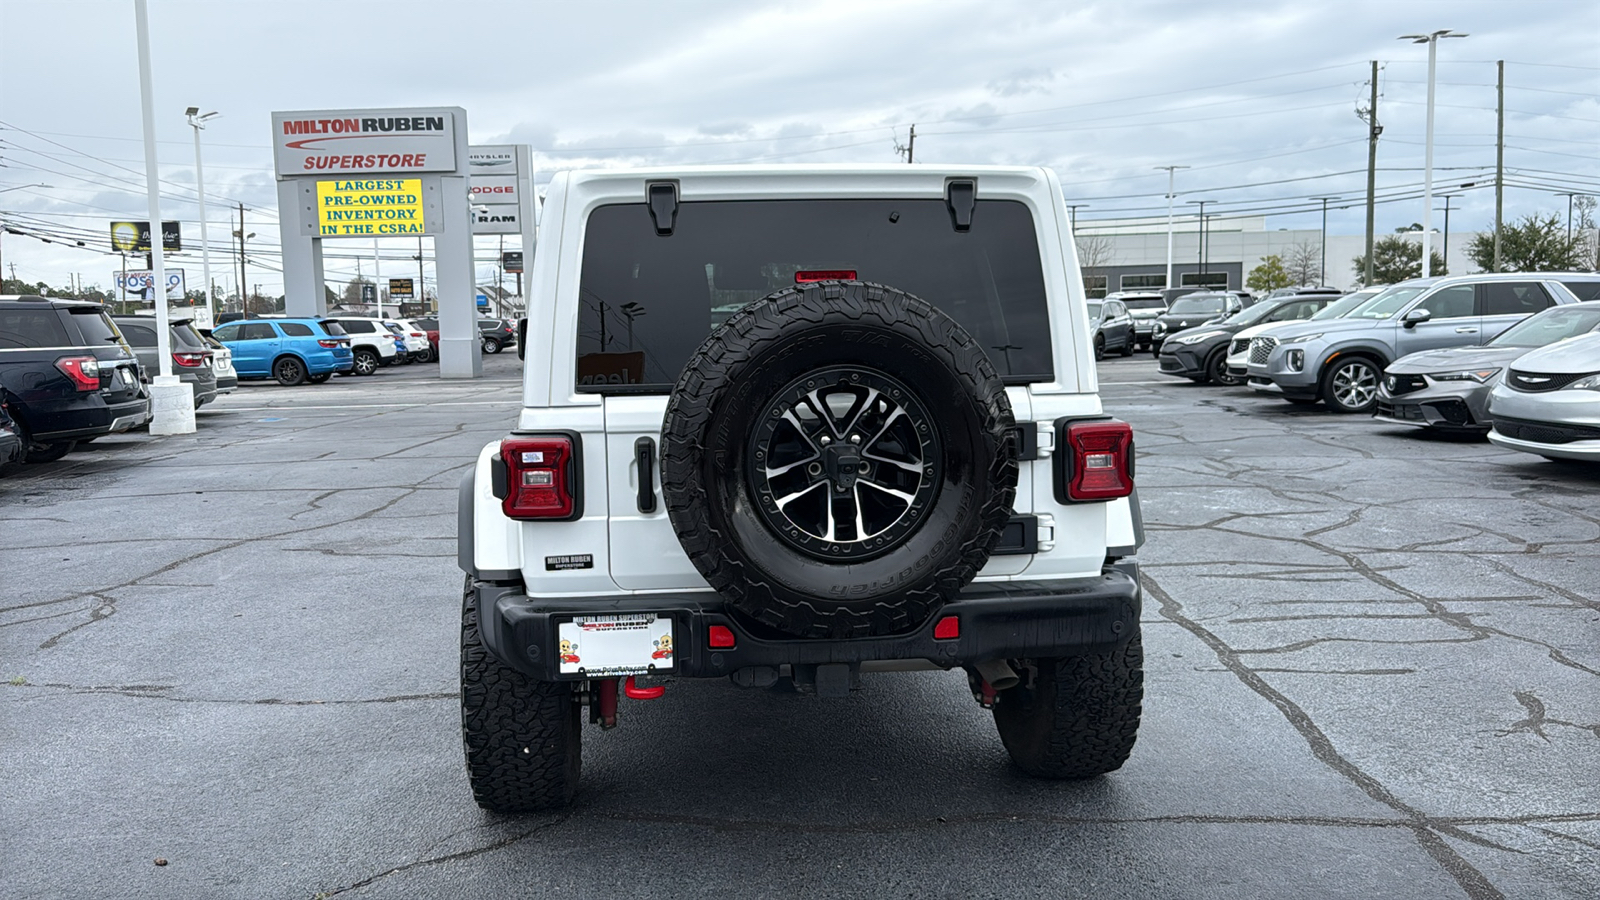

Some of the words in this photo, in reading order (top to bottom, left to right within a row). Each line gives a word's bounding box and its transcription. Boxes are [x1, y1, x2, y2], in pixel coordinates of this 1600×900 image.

[283, 119, 360, 135] MILTON
[362, 117, 444, 132] RUBEN
[303, 154, 426, 170] SUPERSTORE
[335, 180, 404, 191] LARGEST
[472, 186, 514, 194] ODGE
[324, 194, 417, 206] PRE-OWNED
[326, 209, 417, 220] INVENTORY
[321, 225, 338, 234] IN
[342, 224, 374, 234] THE
[378, 223, 423, 234] CSRA!
[117, 275, 180, 288] HOSTO
[547, 556, 570, 565] MILTON
[570, 555, 591, 563] RUBEN
[618, 613, 658, 621] SUPERSTORE
